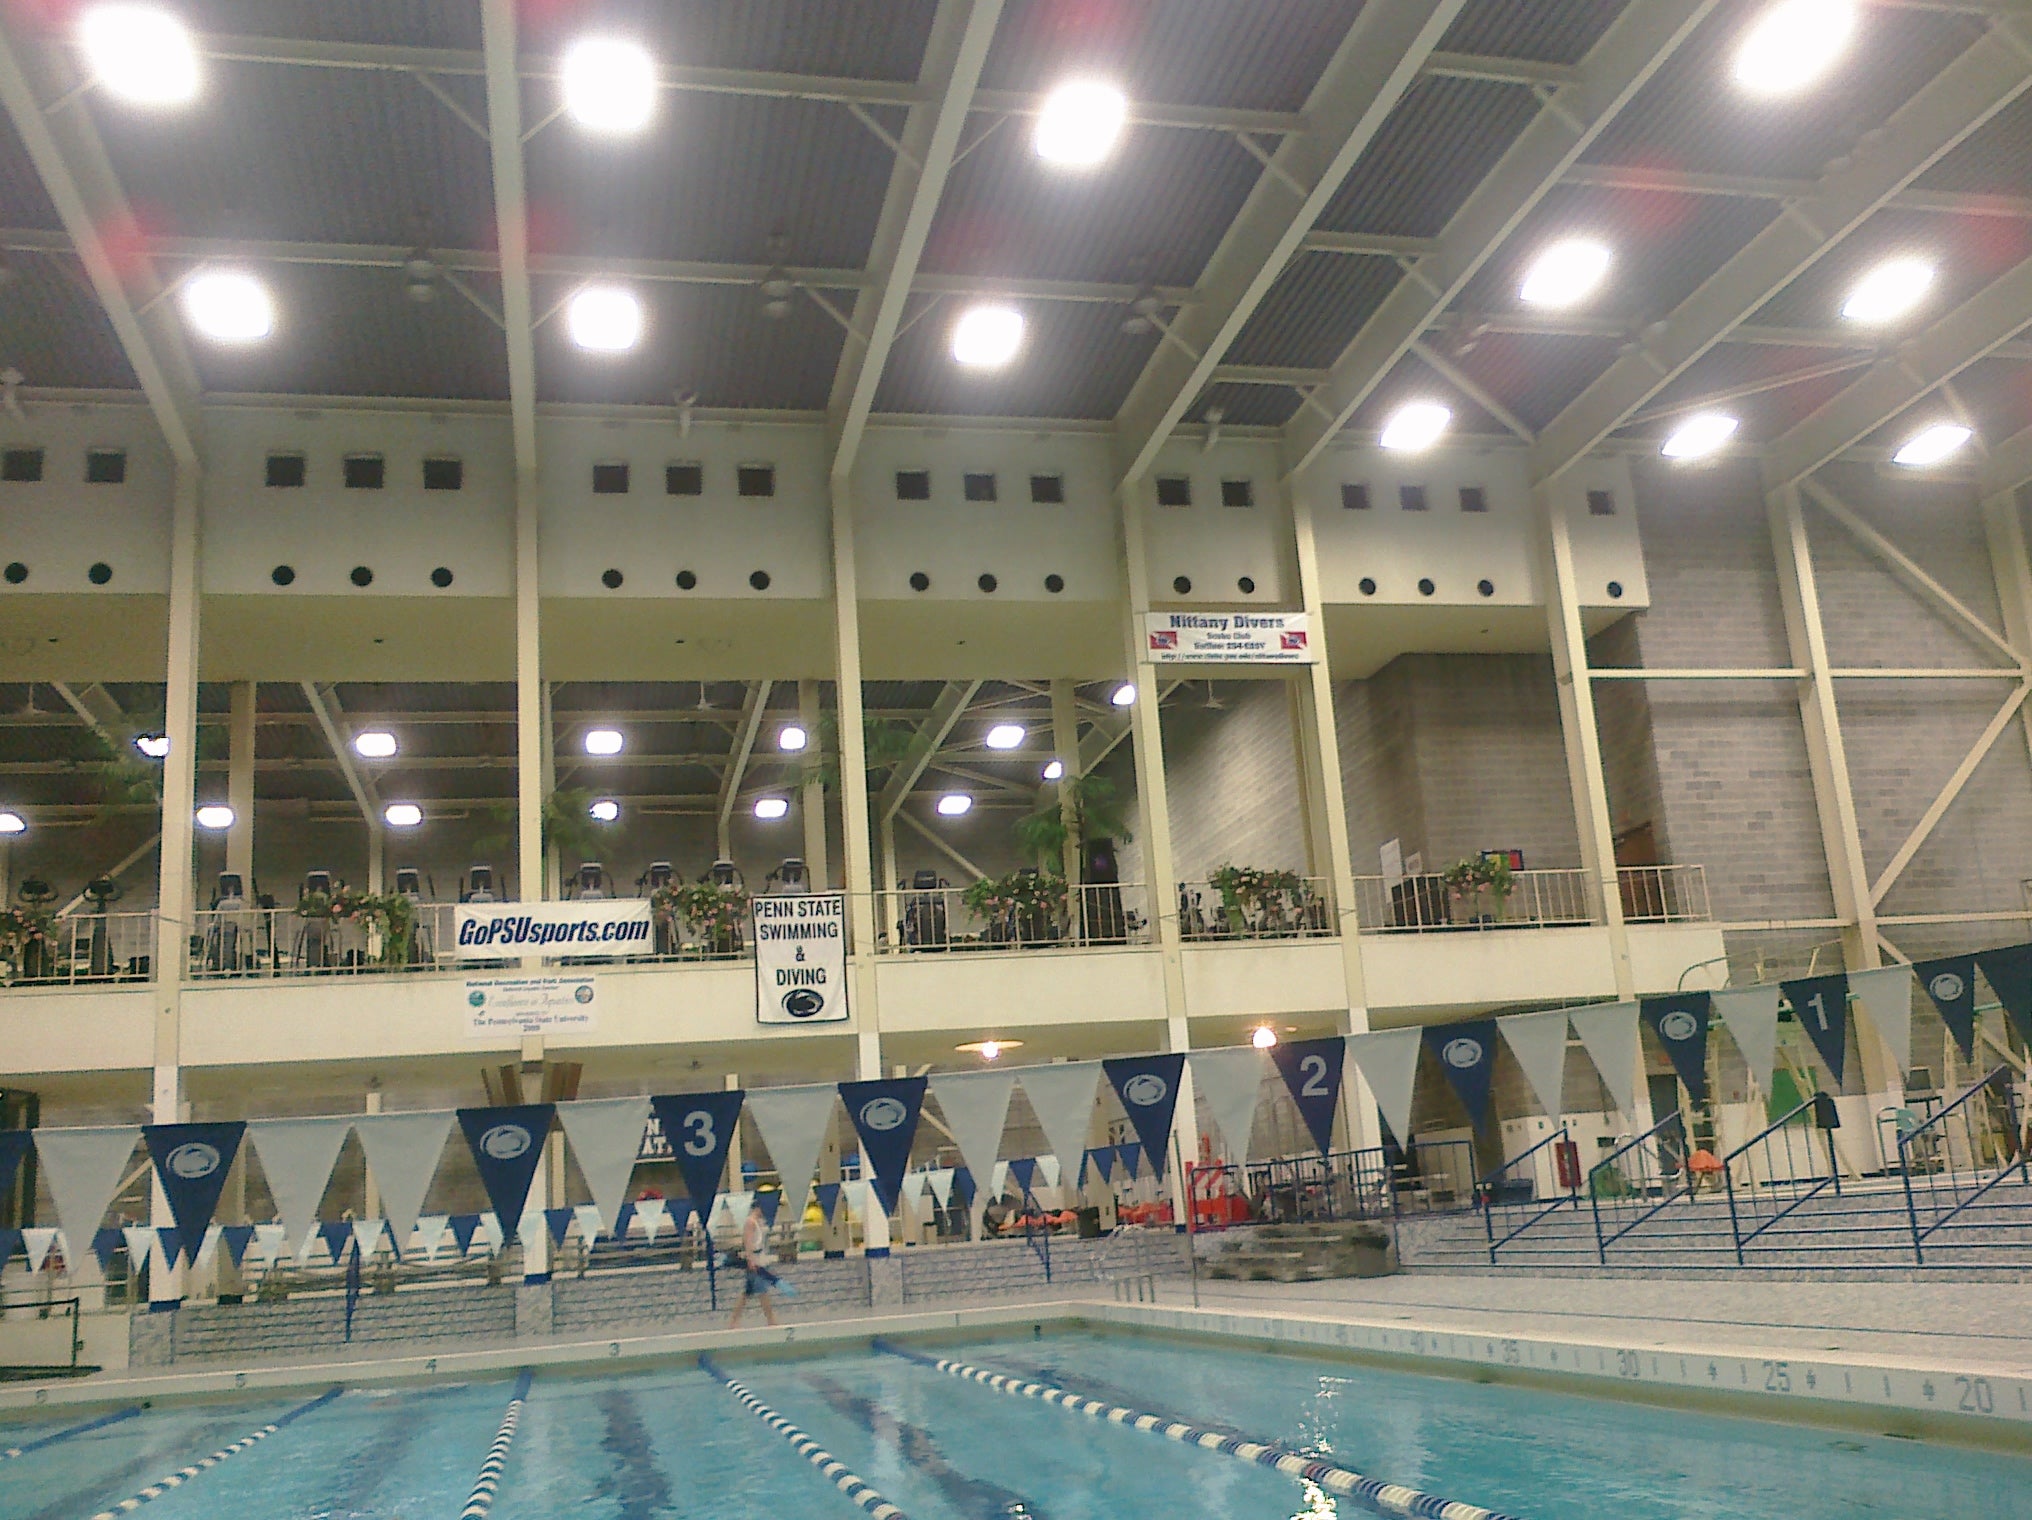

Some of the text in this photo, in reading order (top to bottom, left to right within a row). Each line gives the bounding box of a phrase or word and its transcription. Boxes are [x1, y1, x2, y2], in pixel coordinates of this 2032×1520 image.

[1170, 615, 1285, 630] Nittany Divers
[755, 900, 841, 917] PENN STATE
[459, 917, 649, 945] GoPSUsports.com
[760, 922, 838, 940] SWIMMING
[796, 945, 805, 962] &
[776, 968, 826, 986] DIVING
[1808, 993, 1828, 1031] 1
[1300, 1055, 1329, 1096] 2
[684, 1110, 716, 1156] 3
[425, 1358, 437, 1374] 4
[1616, 1349, 1639, 1377] 30
[1763, 1361, 1791, 1392] 25
[1955, 1375, 1993, 1413] 20
